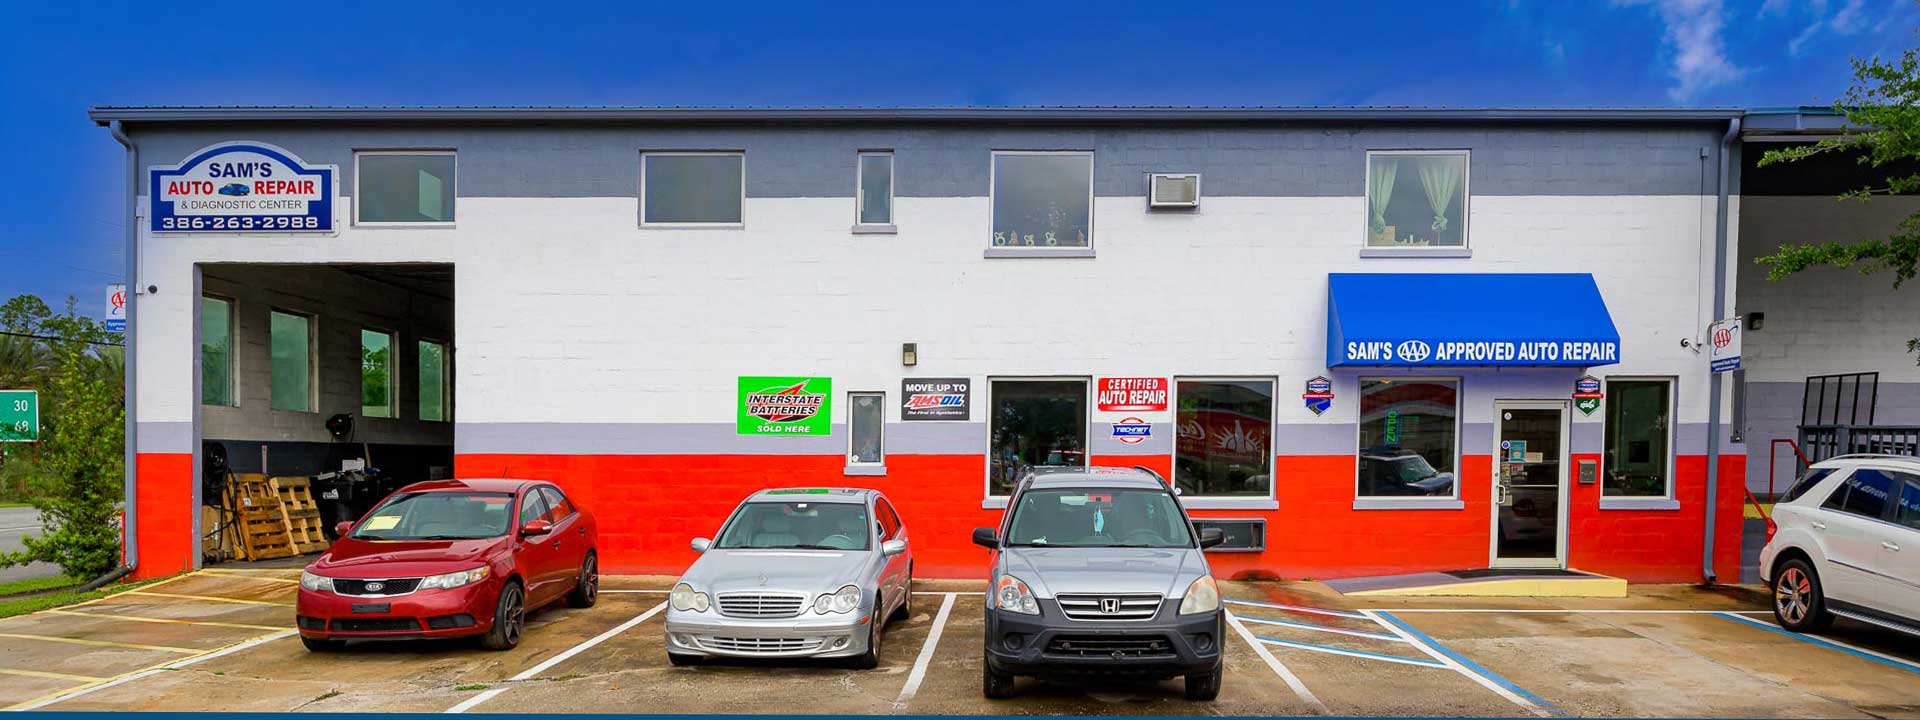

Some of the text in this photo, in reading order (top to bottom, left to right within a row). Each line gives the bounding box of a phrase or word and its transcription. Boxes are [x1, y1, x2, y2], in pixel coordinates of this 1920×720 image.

[209, 162, 272, 178] SAM'S
[168, 180, 315, 195] AUTO REPAIR
[181, 200, 302, 209] & DIAGNOSTIC CENTER
[162, 217, 318, 229] 386-263-2988
[1347, 340, 1616, 361] SAM'S AAA APPROVED AUTO REPAIR
[906, 383, 967, 392] MOVE UP TO
[1108, 379, 1158, 390] CERTIFIED
[748, 395, 822, 404] INTERSTATE
[905, 394, 964, 409] AMSOIL
[1099, 390, 1166, 405] AUTO REPAIR
[14, 400, 28, 411] 30
[750, 405, 816, 415] BATTERIES
[15, 420, 29, 432] 68
[1387, 411, 1397, 442] OPEN
[366, 583, 383, 591] KIA
